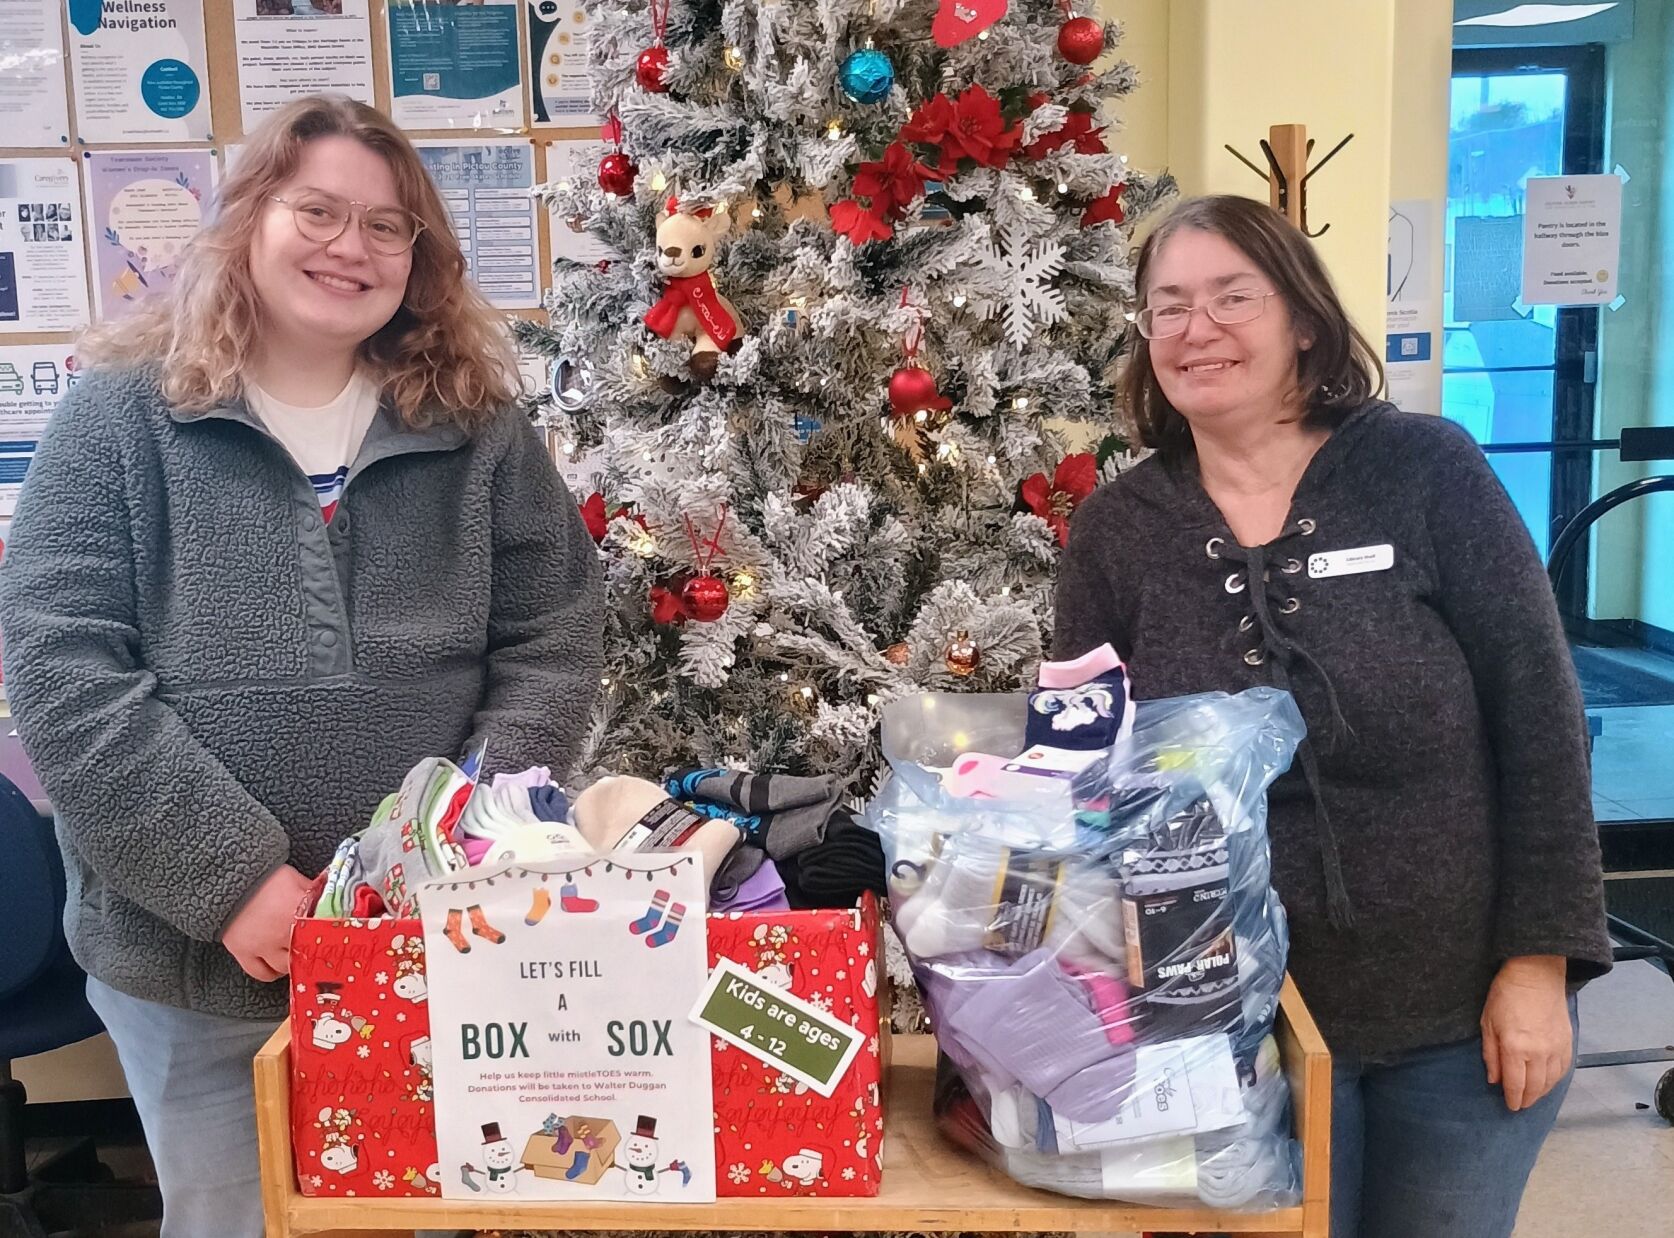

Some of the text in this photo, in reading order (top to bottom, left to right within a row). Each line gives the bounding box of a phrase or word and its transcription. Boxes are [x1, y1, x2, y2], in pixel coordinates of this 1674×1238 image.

[103, 0, 166, 13] Wellness
[99, 16, 177, 32] Navigation
[452, 162, 461, 170] in
[463, 161, 490, 170] Pictou
[492, 161, 522, 171] County
[520, 960, 602, 979] LET'S FILL
[1157, 962, 1192, 979] PAWS
[1196, 953, 1230, 971] POLAR
[558, 994, 568, 1011] A
[726, 978, 841, 1051] Kids are ages
[461, 1019, 674, 1060] BOX with SOX
[740, 1025, 755, 1040] 4
[768, 1037, 787, 1057] 12
[480, 1072, 501, 1081] Help
[517, 1071, 541, 1080] keep
[543, 1070, 565, 1078] little
[567, 1070, 621, 1078] mistleTOES
[624, 1070, 654, 1078] warm.
[468, 1084, 516, 1093] Donations
[519, 1083, 536, 1091] will
[552, 1082, 580, 1090] taken
[594, 1082, 626, 1090] Walter
[629, 1081, 667, 1091] Duggan
[519, 1094, 581, 1103] Consolidated
